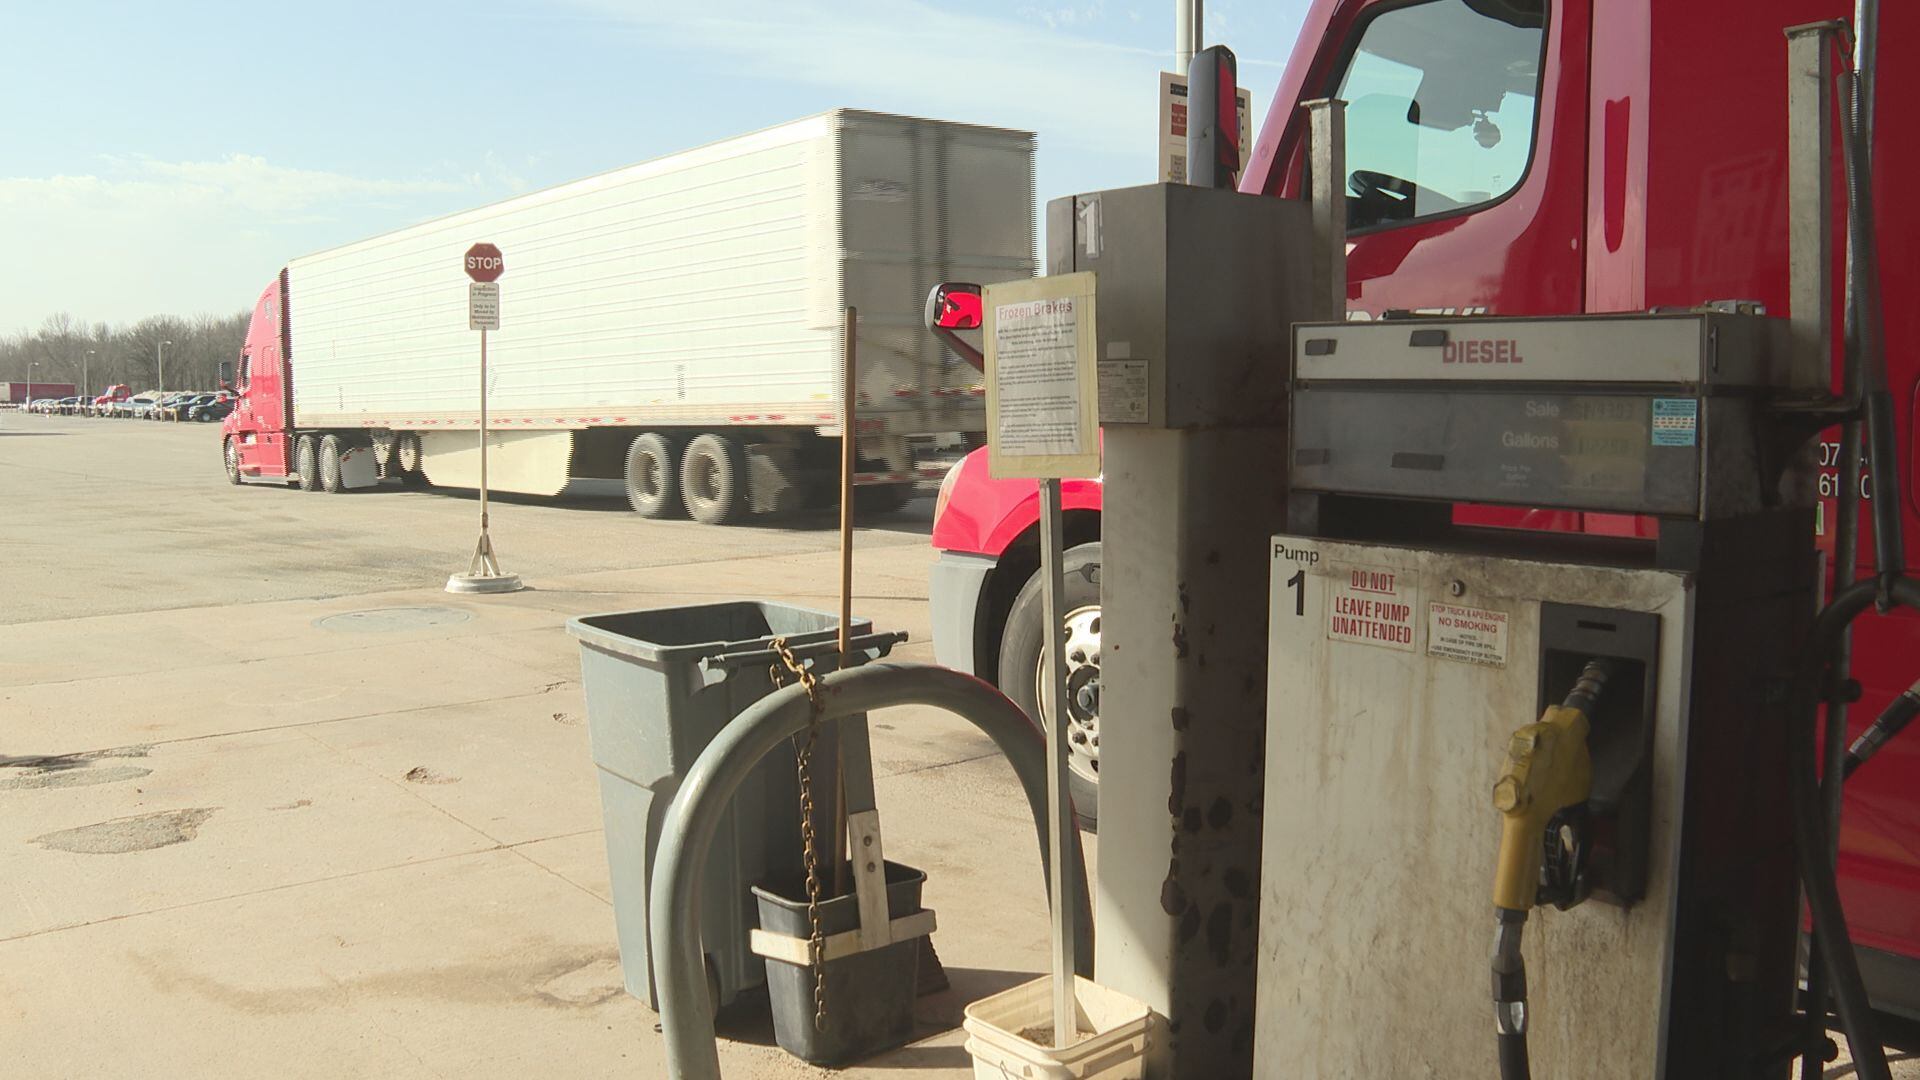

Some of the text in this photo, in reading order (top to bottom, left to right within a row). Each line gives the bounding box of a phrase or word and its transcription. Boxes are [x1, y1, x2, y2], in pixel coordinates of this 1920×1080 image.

[1079, 200, 1096, 255] 1
[467, 256, 502, 270] STOP
[999, 301, 1073, 320] Frozen Brakes
[1442, 340, 1523, 364] DIESEL
[1525, 400, 1560, 417] Sale
[1502, 431, 1559, 448] Gallons
[1274, 544, 1319, 566] Pump
[1351, 570, 1396, 592] DO NOT
[1287, 570, 1305, 616] 1
[1335, 596, 1410, 623] LEAVE PUMP
[1431, 604, 1446, 613] STOP
[1447, 606, 1466, 616] TRUCK
[1484, 611, 1506, 623] ENGINE
[1332, 616, 1411, 644] UNATTENDED
[1438, 617, 1497, 634] NO SMOKING
